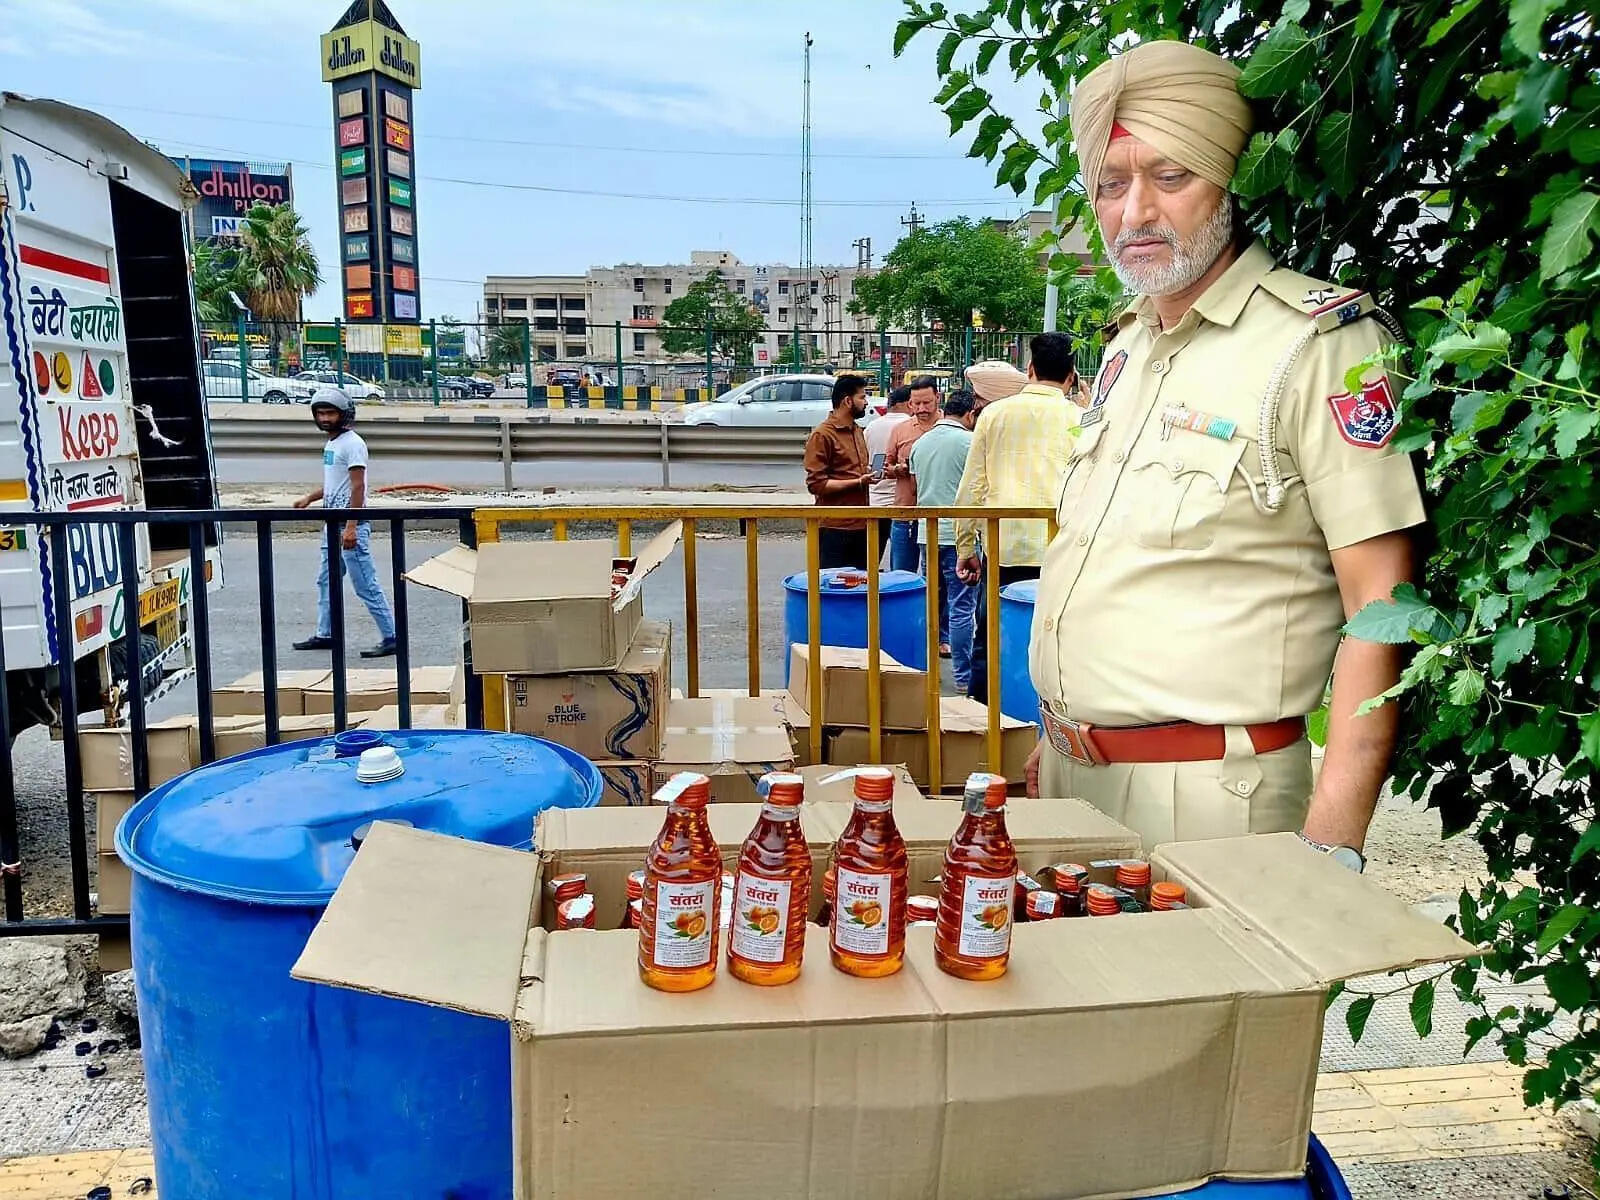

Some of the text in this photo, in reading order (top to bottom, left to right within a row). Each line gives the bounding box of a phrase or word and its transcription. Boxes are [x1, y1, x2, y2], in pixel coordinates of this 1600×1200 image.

[328, 35, 366, 70] dhillon
[380, 35, 415, 77] dhillon
[201, 164, 283, 199] dhillon
[28, 285, 121, 343] बेटी बचाओ
[58, 405, 118, 461] Keep
[93, 465, 118, 496] वाले
[67, 522, 120, 599] BLO
[547, 712, 586, 723] STROKE
[554, 704, 580, 714] BLUE
[669, 893, 704, 906] संतरा
[745, 886, 779, 902] संतरा
[846, 881, 880, 896] संतरा
[976, 887, 1009, 900] संतरा
